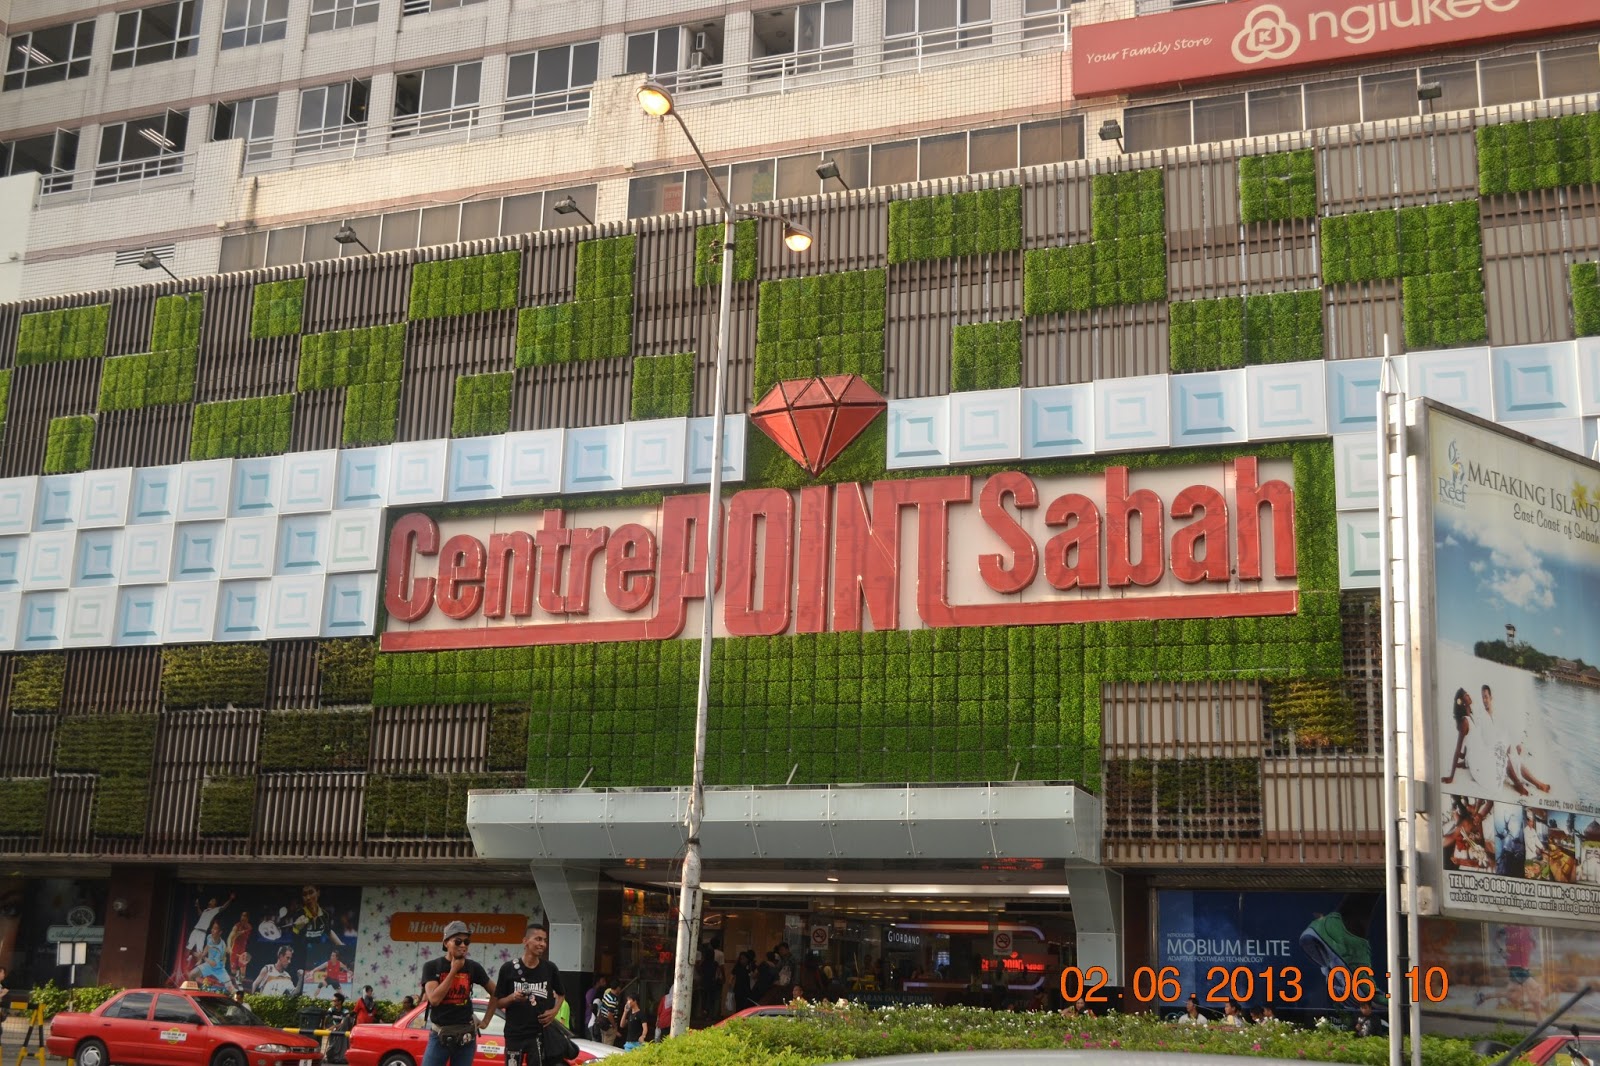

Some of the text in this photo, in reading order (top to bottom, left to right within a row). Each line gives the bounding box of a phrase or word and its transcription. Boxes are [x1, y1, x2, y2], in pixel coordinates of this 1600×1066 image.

[1086, 36, 1213, 64] Your Family Store
[1438, 476, 1468, 503] Reef
[1467, 460, 1545, 506] MATAKING
[977, 456, 1297, 594] Sabah
[1513, 502, 1600, 545] East Coast of Sabah
[1449, 873, 1463, 889] TEL
[1464, 875, 1478, 891] NO:
[1479, 877, 1490, 892] +6
[1491, 878, 1506, 894] 089
[1507, 881, 1536, 897] 770022
[1537, 883, 1551, 899] FAX
[1552, 885, 1565, 900] NO:
[1566, 887, 1576, 902] +6
[1576, 888, 1590, 903] 089
[1449, 890, 1478, 904] website:
[1479, 894, 1537, 911] www.mataking.com
[1539, 899, 1557, 912] email:
[468, 923, 506, 935] Shoes
[1167, 938, 1291, 957] MOBIUM ELITE
[1194, 955, 1226, 963] FOOTWEAR
[1226, 956, 1264, 964] TECHNOLOGY
